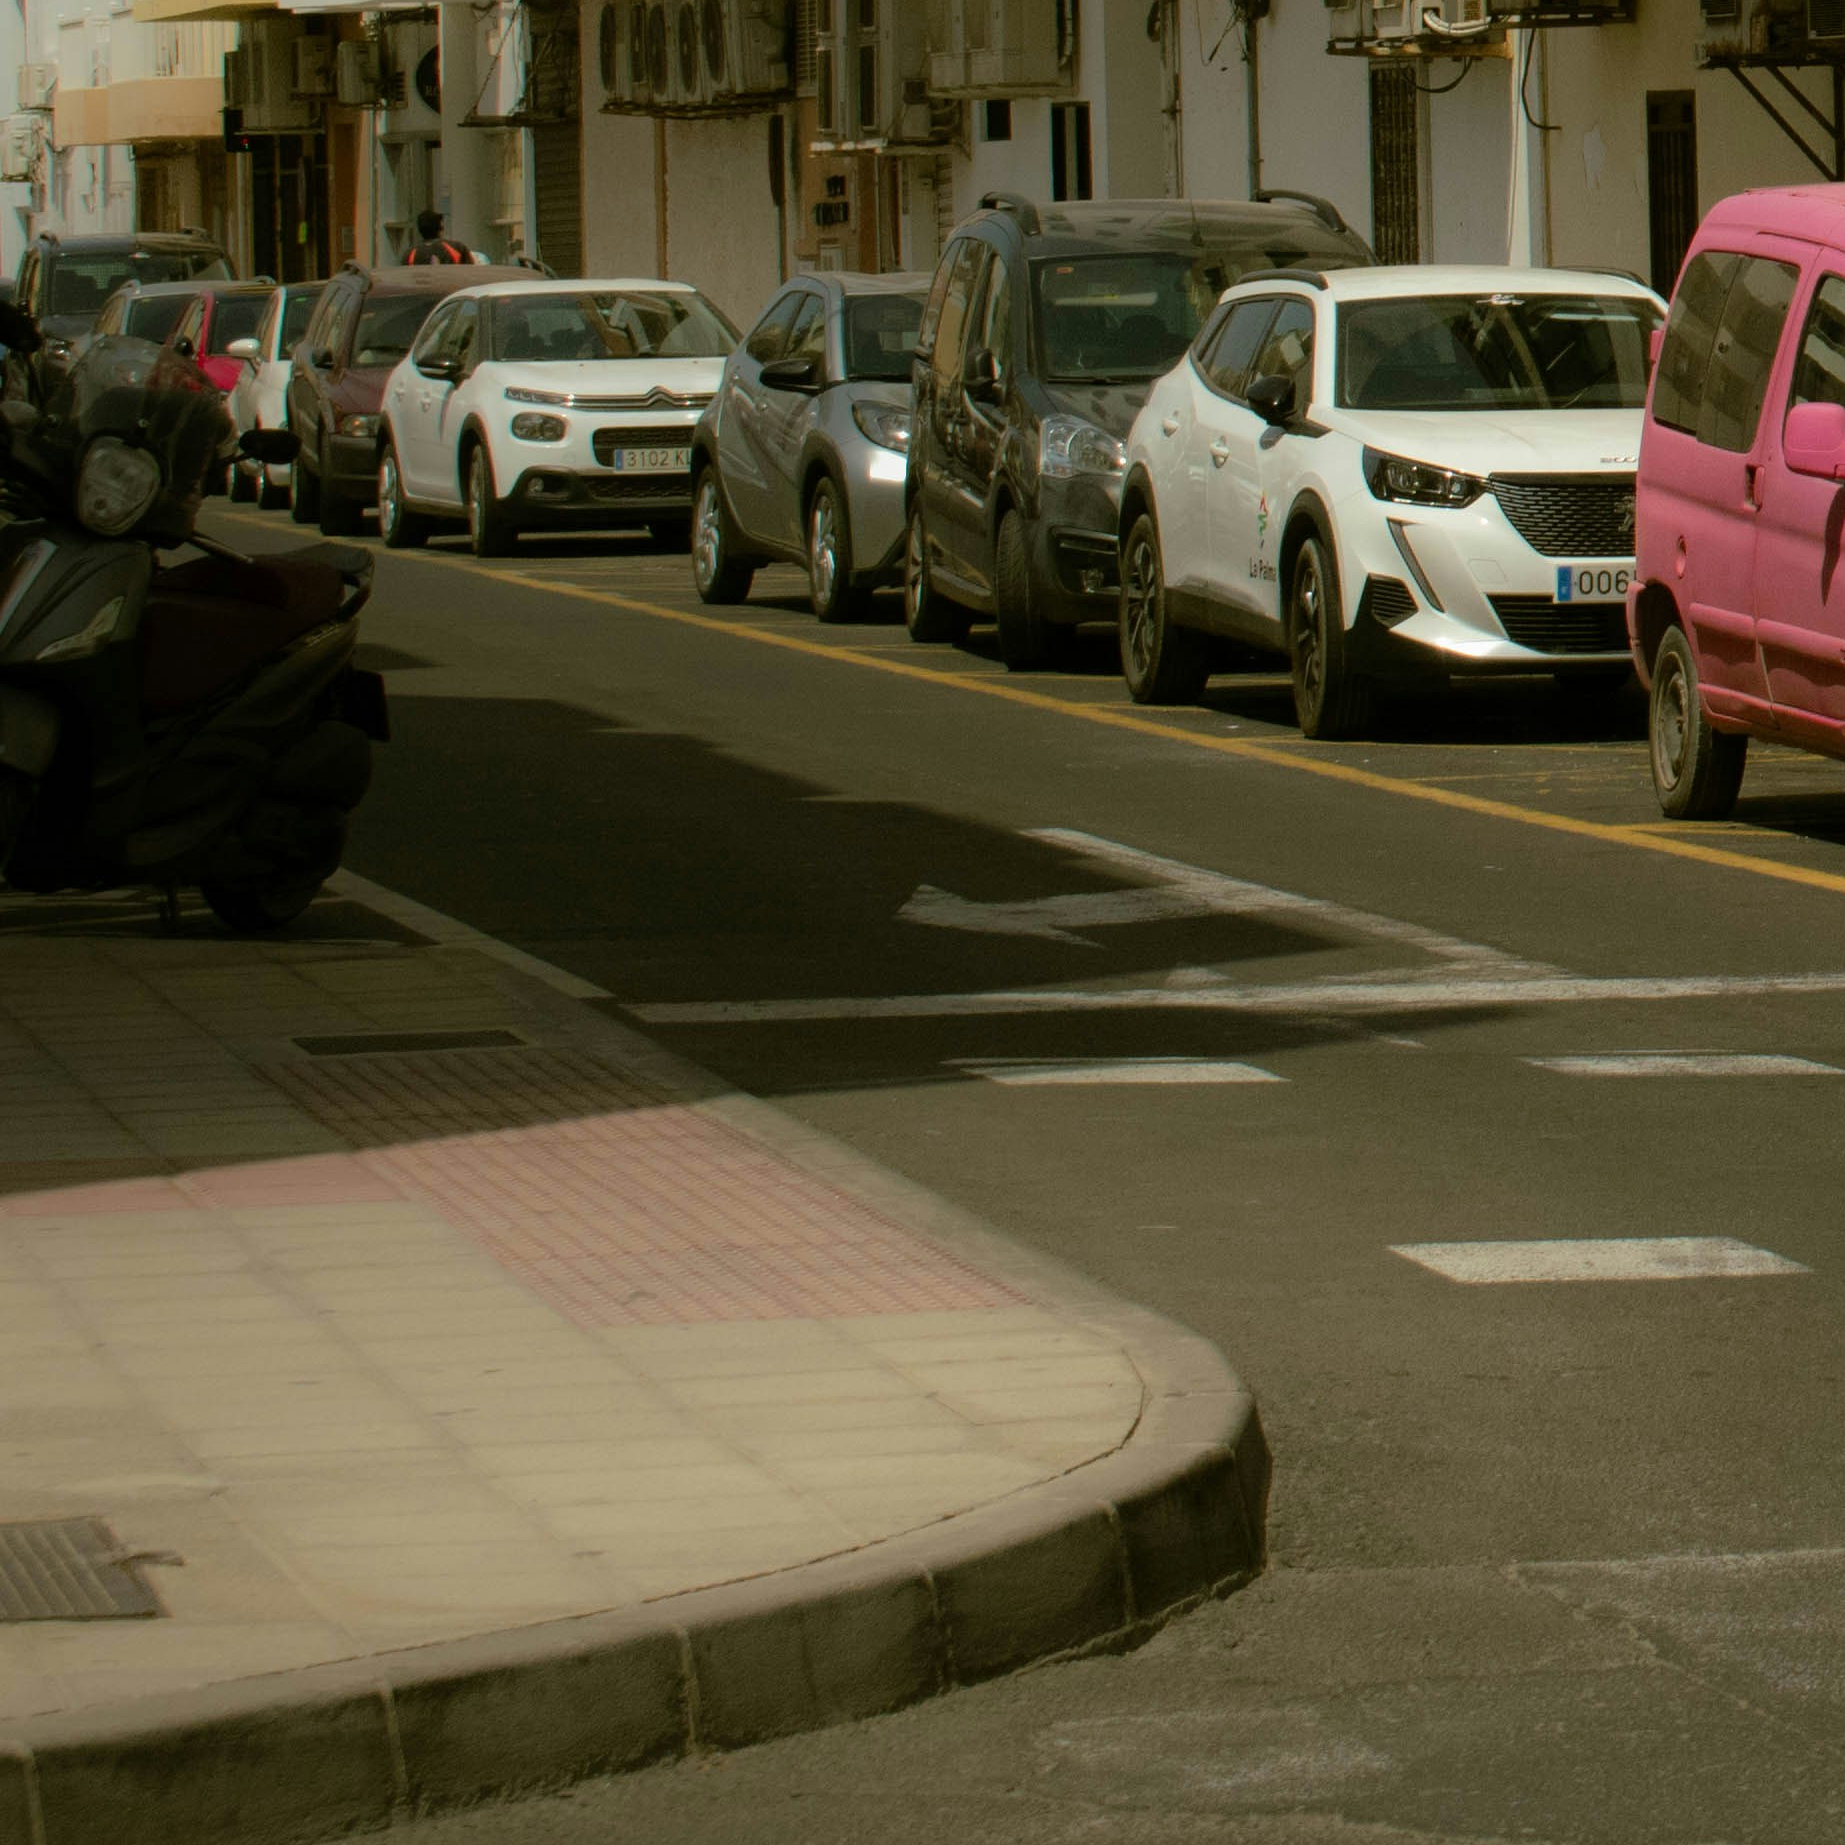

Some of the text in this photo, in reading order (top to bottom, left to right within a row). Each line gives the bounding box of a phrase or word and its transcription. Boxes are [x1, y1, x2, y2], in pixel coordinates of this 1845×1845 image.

[627, 450, 669, 467] 3102
[1249, 557, 1257, 578] La
[1579, 569, 1637, 595] 006
